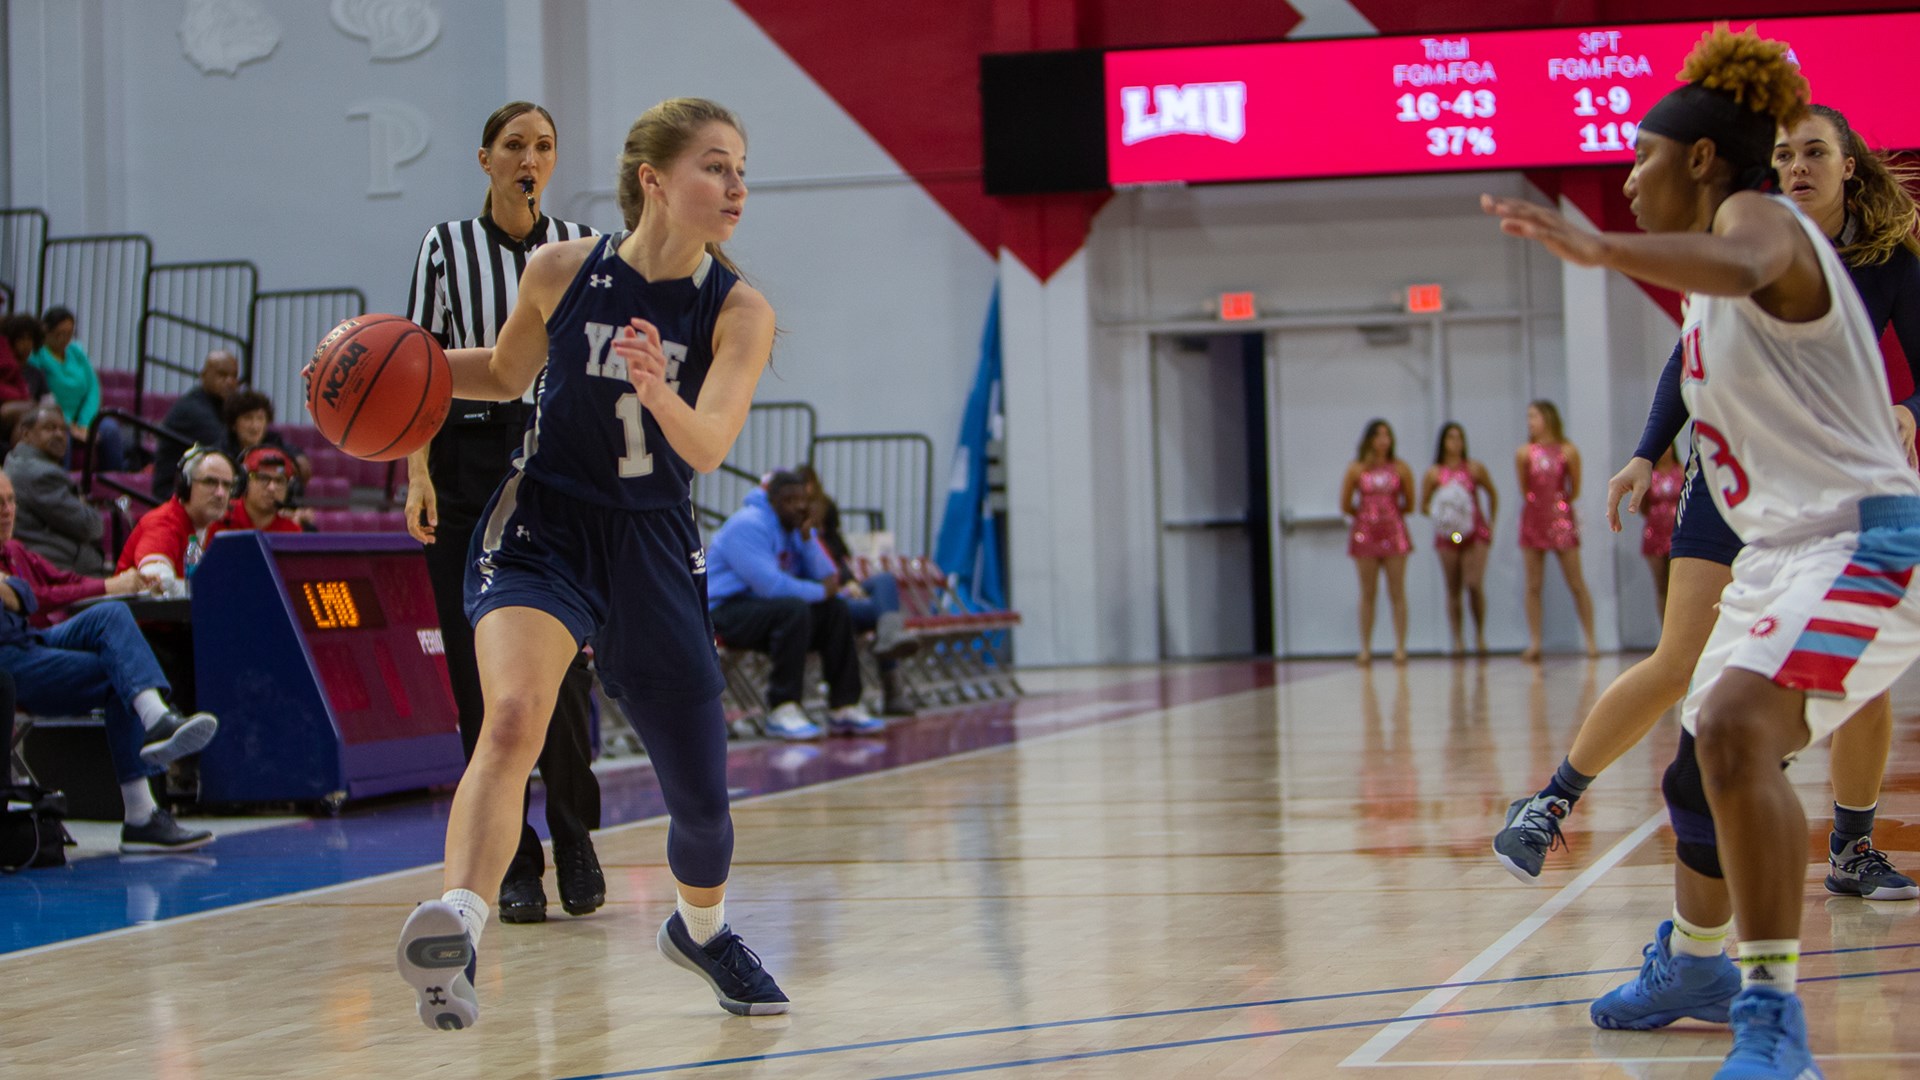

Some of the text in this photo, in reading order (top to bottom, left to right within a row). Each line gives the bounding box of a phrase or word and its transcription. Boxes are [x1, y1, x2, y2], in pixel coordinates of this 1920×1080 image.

[1420, 37, 1470, 61] Total
[1578, 31, 1622, 55] 3PT
[1120, 81, 1247, 146] LMU
[1396, 89, 1497, 122] 16-43
[1573, 86, 1631, 116] 1-9
[1426, 126, 1497, 156] 37%
[322, 340, 369, 409] NCAA
[615, 392, 654, 479] 1
